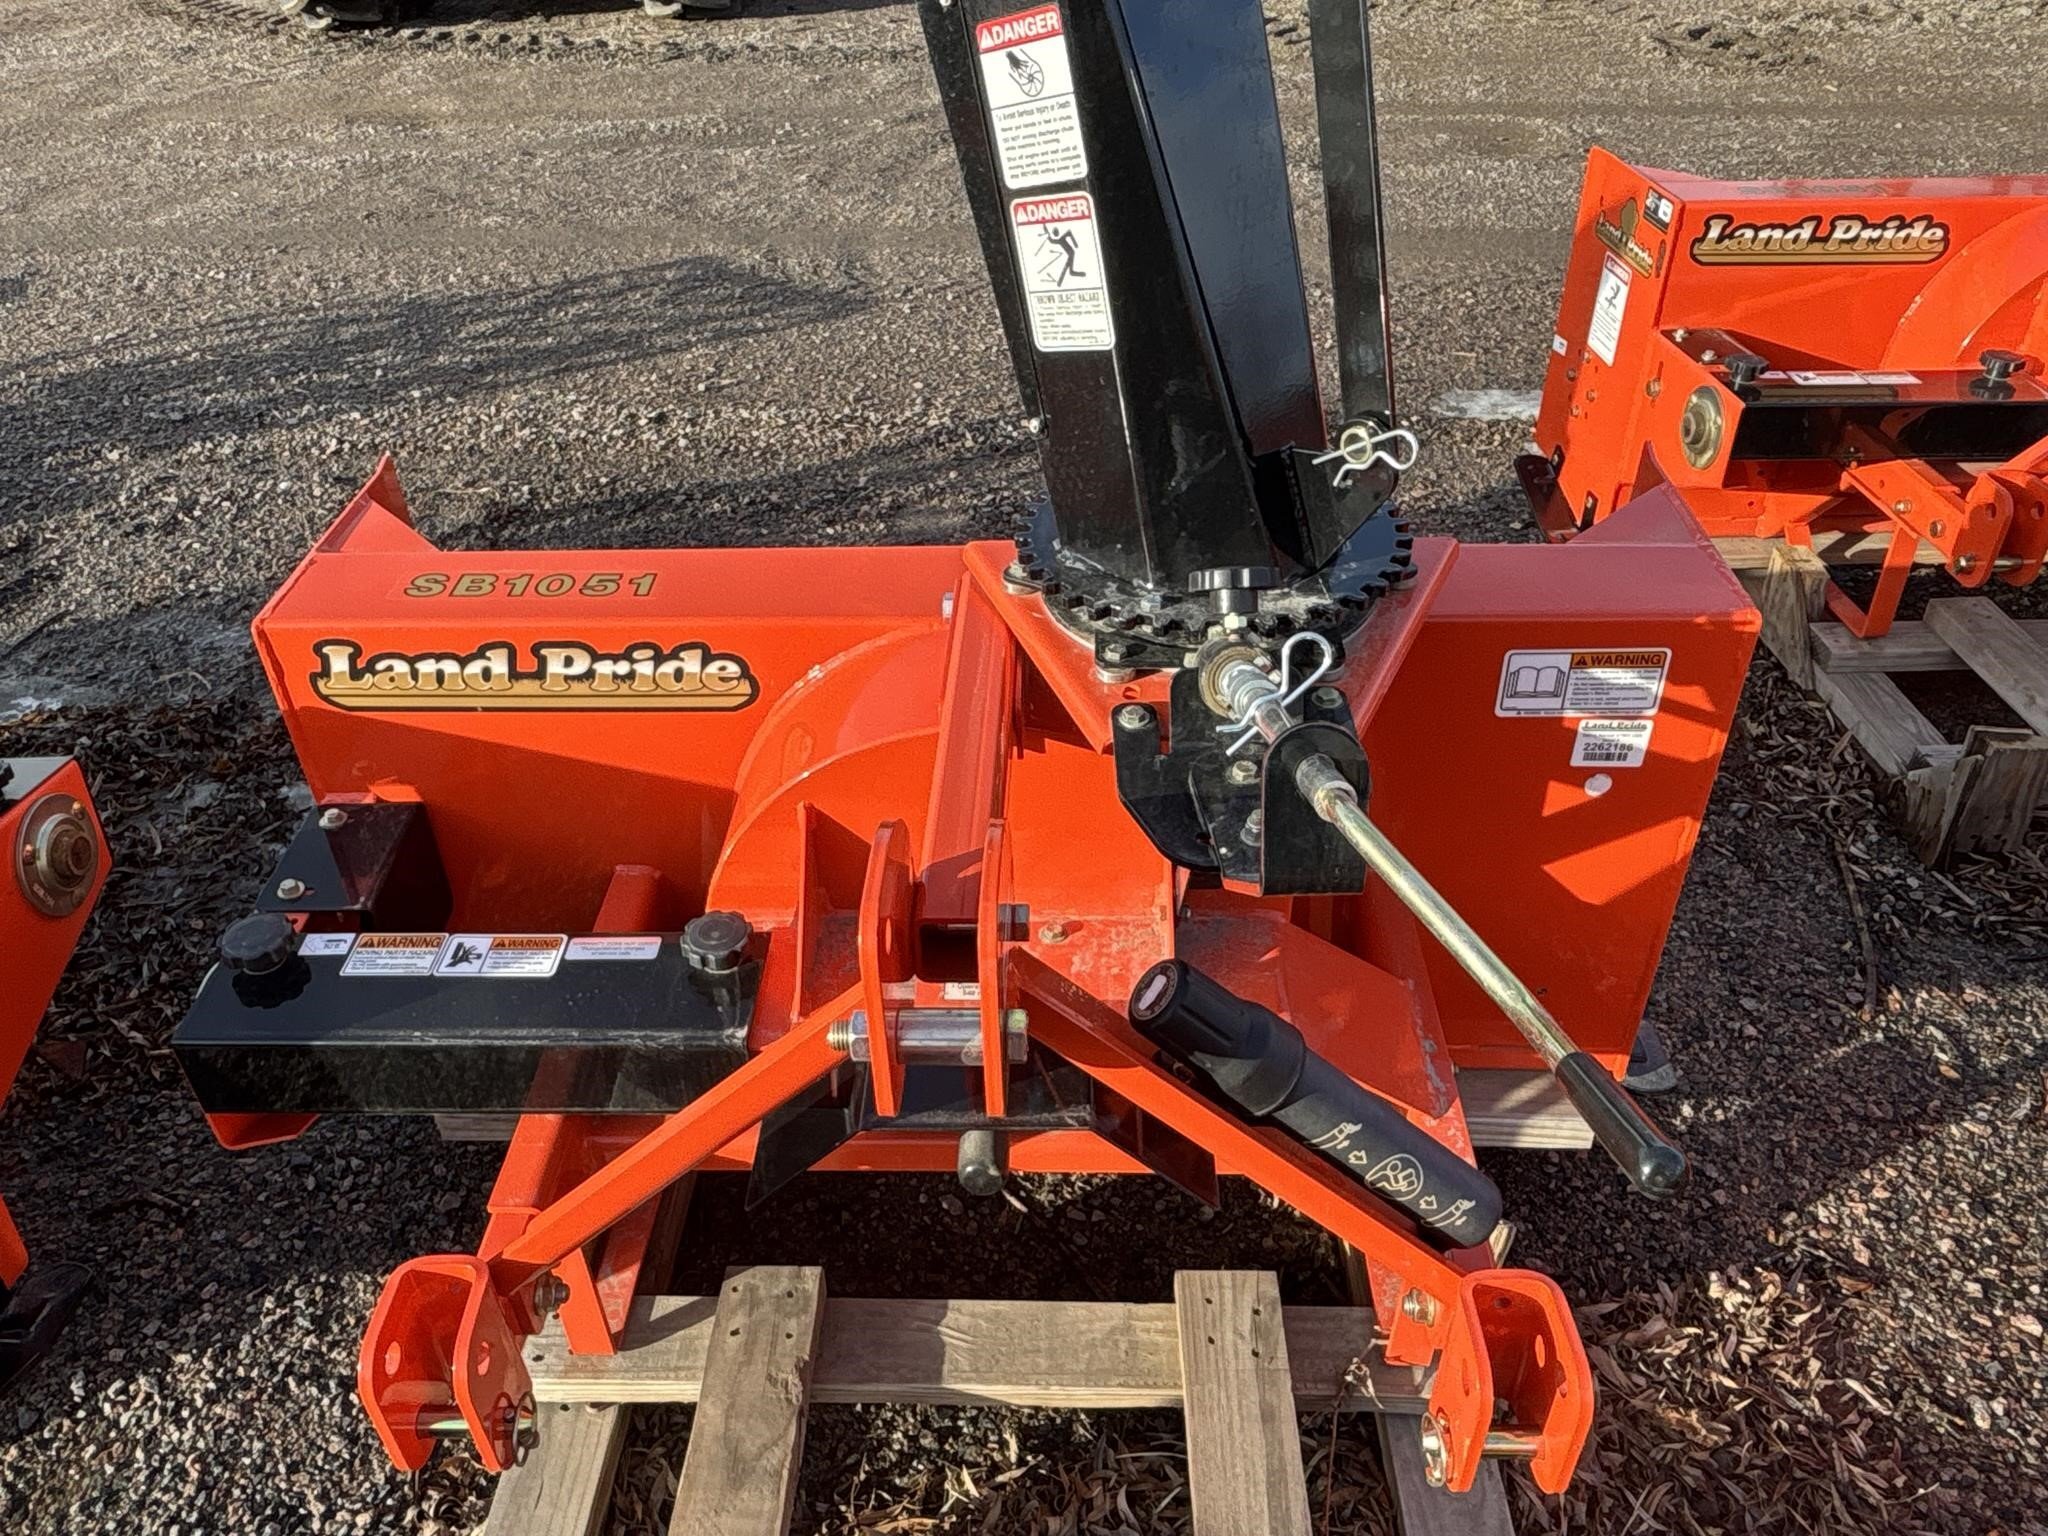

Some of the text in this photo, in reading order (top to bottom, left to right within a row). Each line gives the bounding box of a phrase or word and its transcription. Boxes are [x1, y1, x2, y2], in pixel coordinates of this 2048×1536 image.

[991, 11, 1060, 46] DANGER
[1026, 200, 1089, 222] DANGER
[1698, 214, 1947, 253] Land Pride
[402, 572, 658, 598] SB1051
[321, 643, 745, 692] Land Pride
[1590, 653, 1662, 667] WARNING
[1583, 743, 1634, 752] 2262186
[376, 937, 440, 948] WARNING
[508, 940, 559, 948] WARNING
